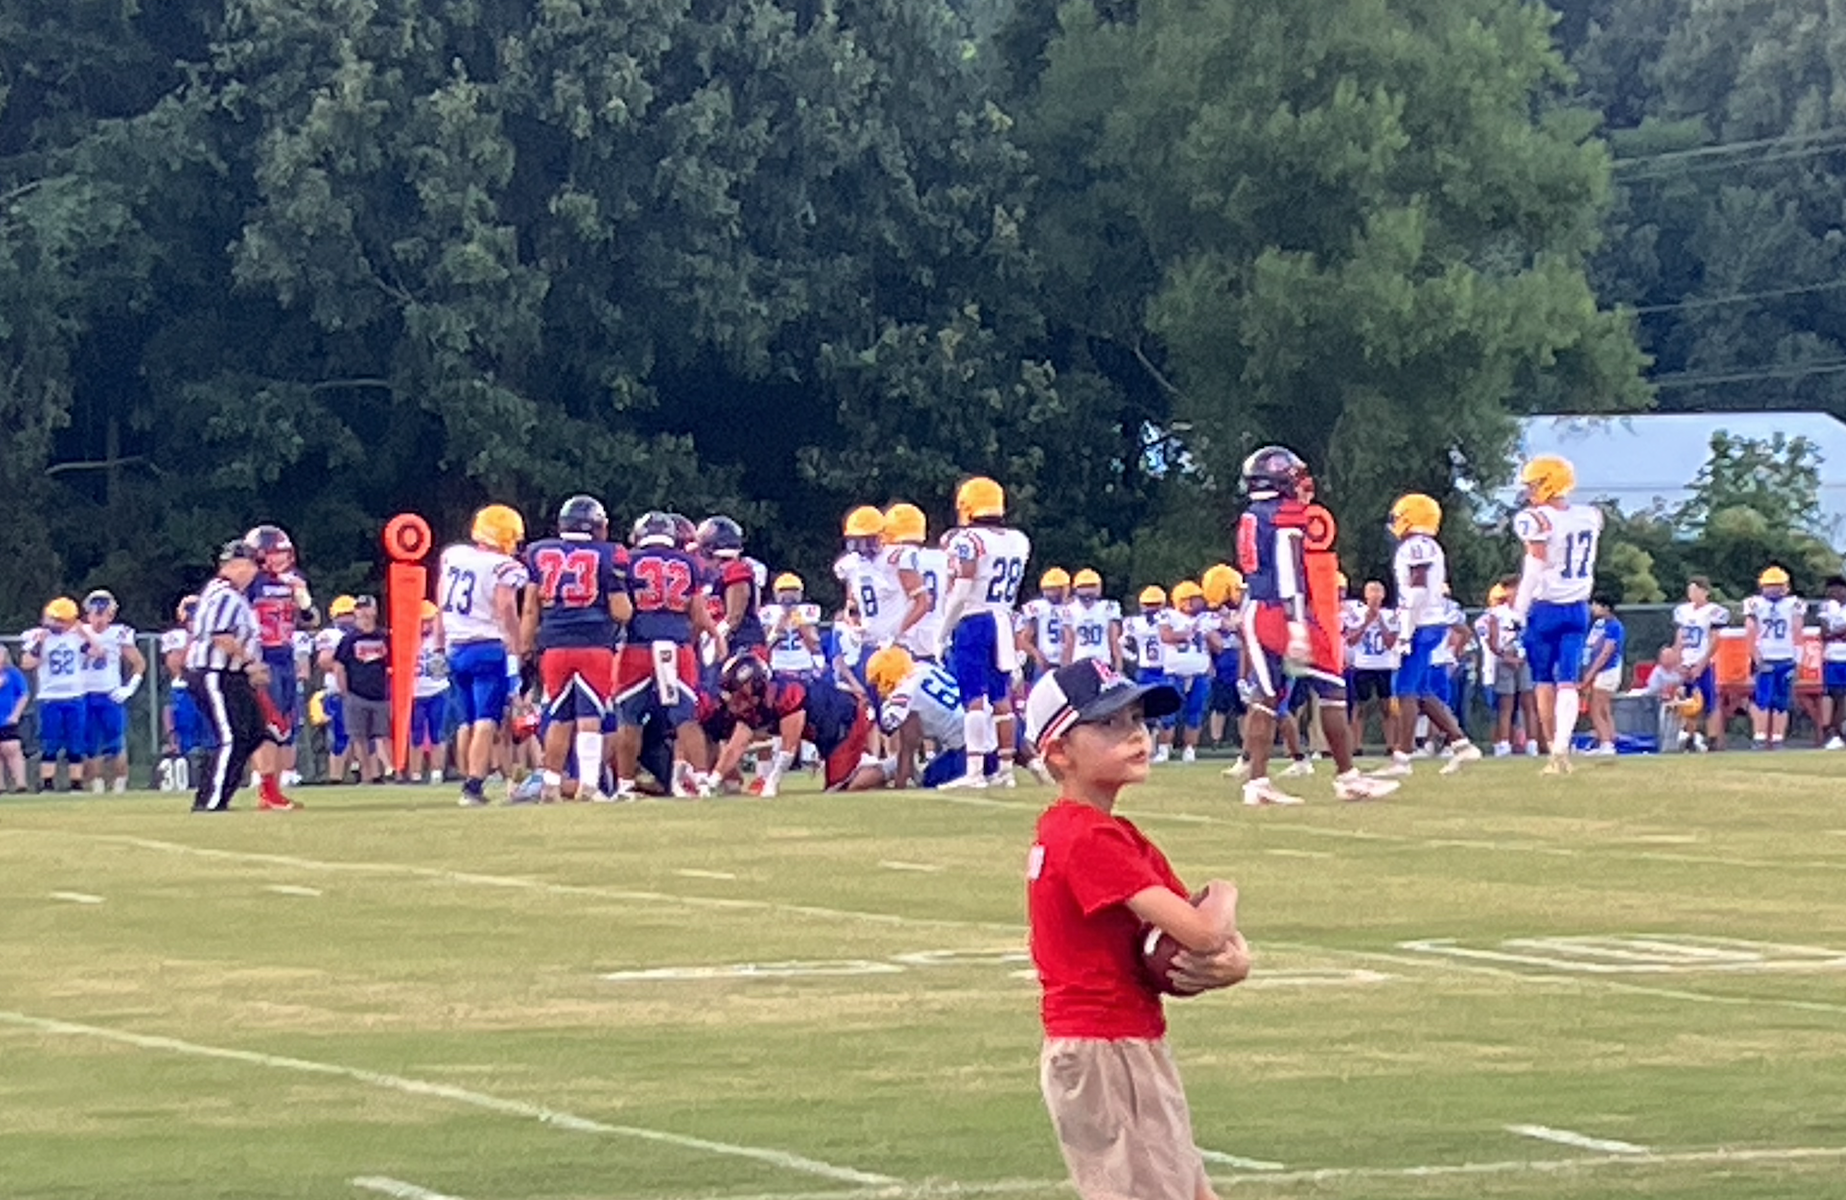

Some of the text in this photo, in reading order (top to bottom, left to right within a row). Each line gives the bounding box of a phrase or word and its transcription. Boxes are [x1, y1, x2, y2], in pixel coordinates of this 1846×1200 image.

[535, 548, 600, 607] 73
[1561, 529, 1592, 579] 17
[445, 567, 475, 615] 73
[634, 556, 692, 611] 32
[860, 584, 878, 617] 8
[985, 557, 1022, 604] 28
[1146, 637, 1160, 661] 6
[1762, 618, 1787, 639] 70
[157, 757, 189, 791] 30
